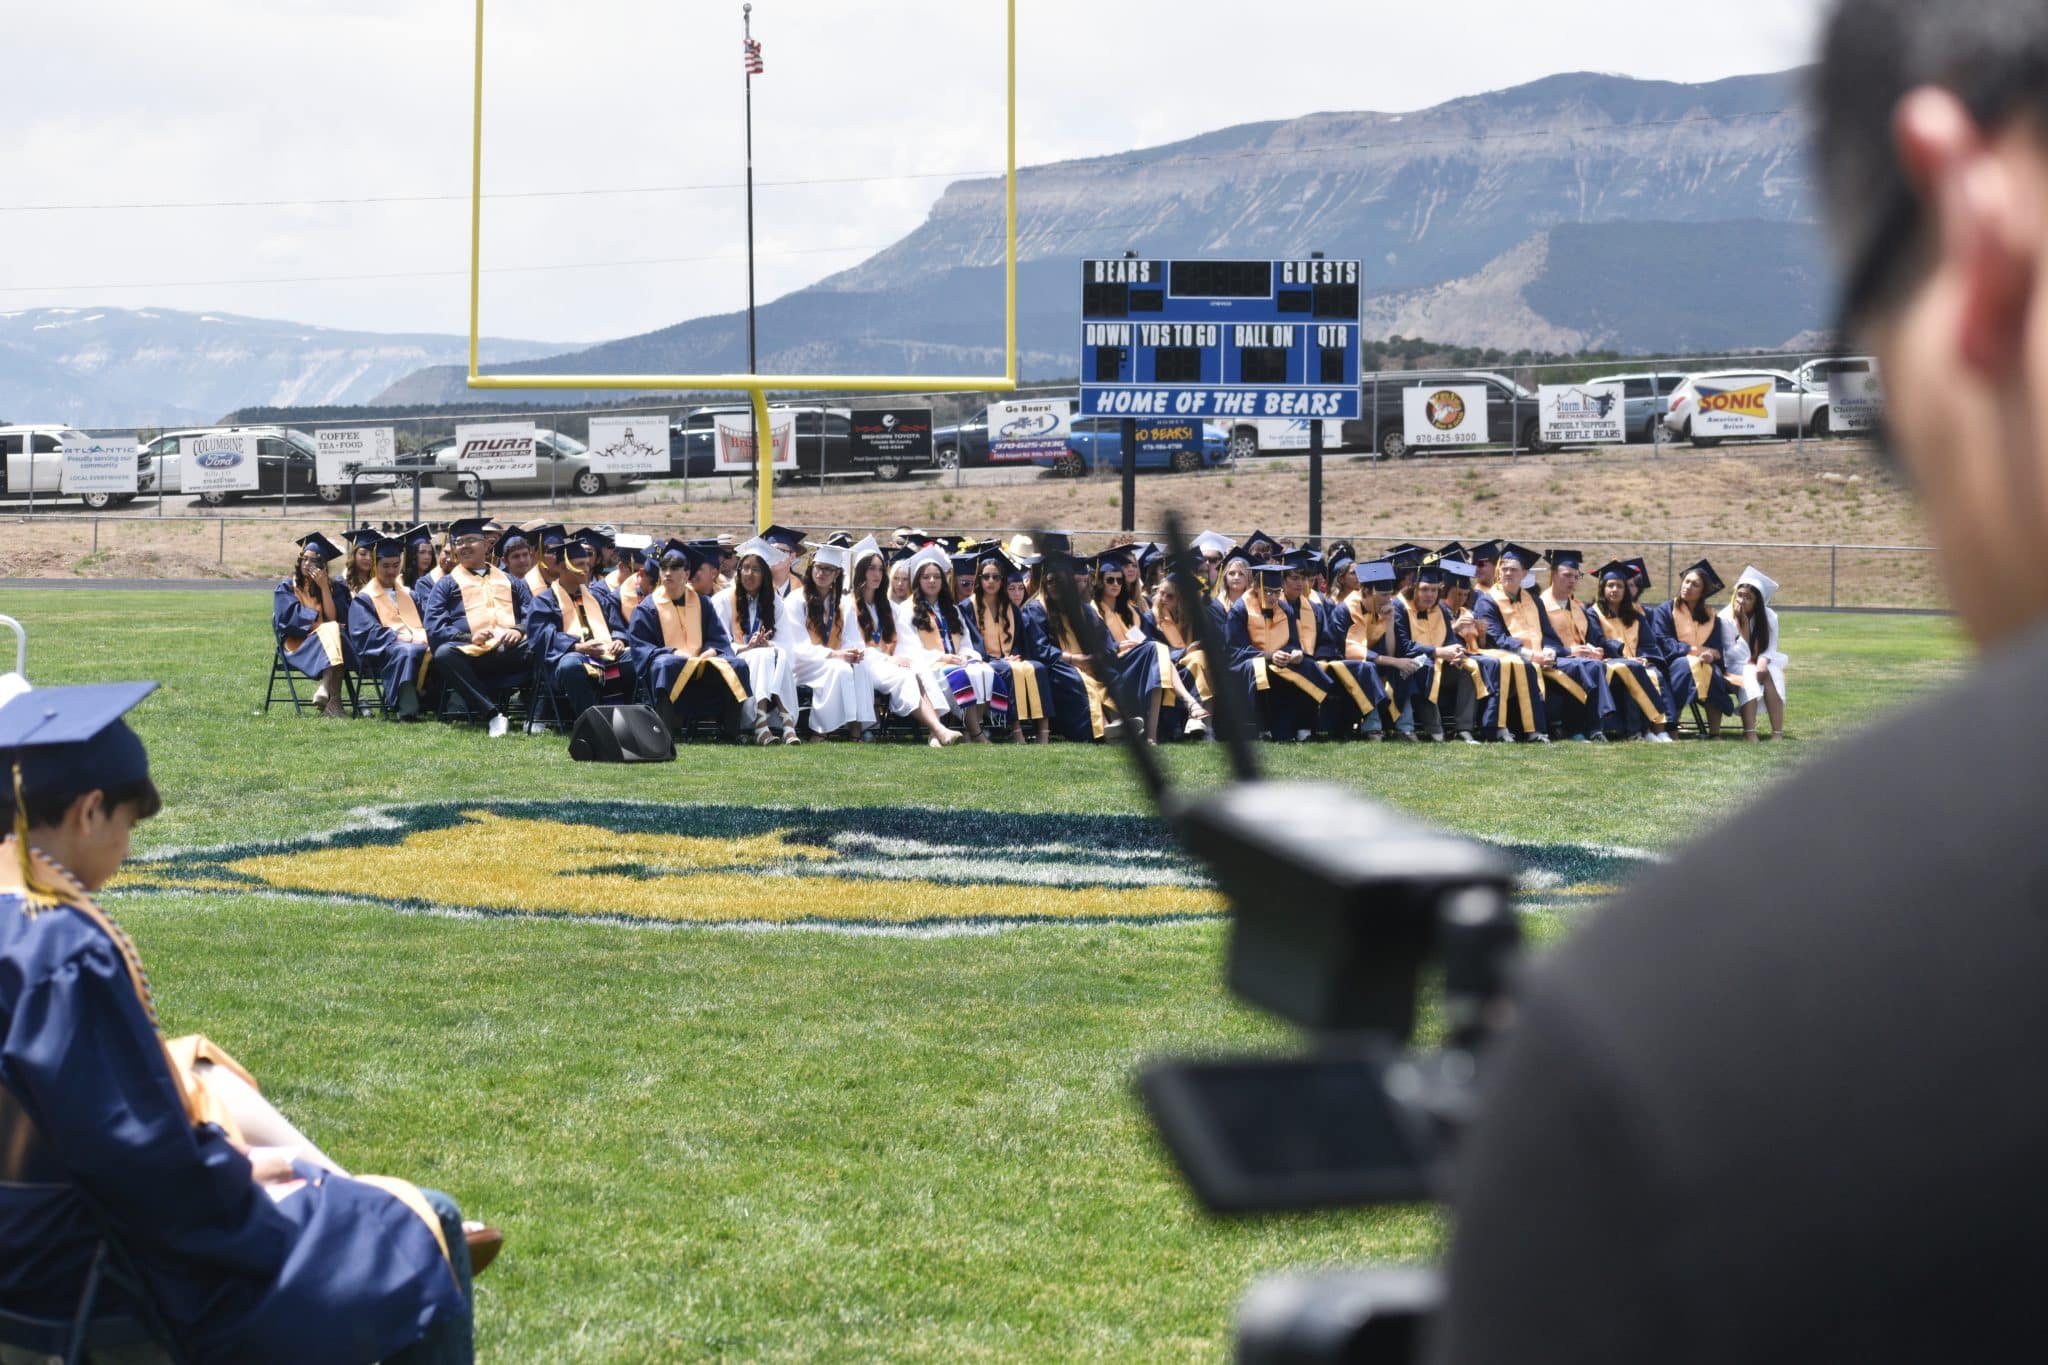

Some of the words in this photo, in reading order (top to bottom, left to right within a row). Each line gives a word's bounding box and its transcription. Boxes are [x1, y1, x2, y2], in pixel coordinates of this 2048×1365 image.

[1095, 261, 1150, 283] BEARS
[1283, 261, 1357, 284] GUESTS
[1086, 325, 1130, 346] DOWN
[1142, 325, 1170, 346] YDS
[1173, 325, 1192, 346] TO
[1196, 325, 1217, 346] GO
[1235, 325, 1268, 346] BALL
[1273, 325, 1294, 347] ON
[1317, 325, 1347, 348] QTR
[1097, 391, 1169, 414] HOME
[1175, 392, 1206, 414] OF
[1213, 392, 1257, 414] THE
[1264, 392, 1342, 416] BEARS
[1701, 393, 1765, 410] SONIC
[320, 431, 360, 441] COFFEE
[340, 441, 363, 449] FOOD
[1545, 431, 1562, 440] THE
[1565, 430, 1591, 440] RIFLE
[1593, 429, 1621, 439] BEARS
[193, 437, 244, 456] COLUMBINE
[205, 453, 234, 466] Ford
